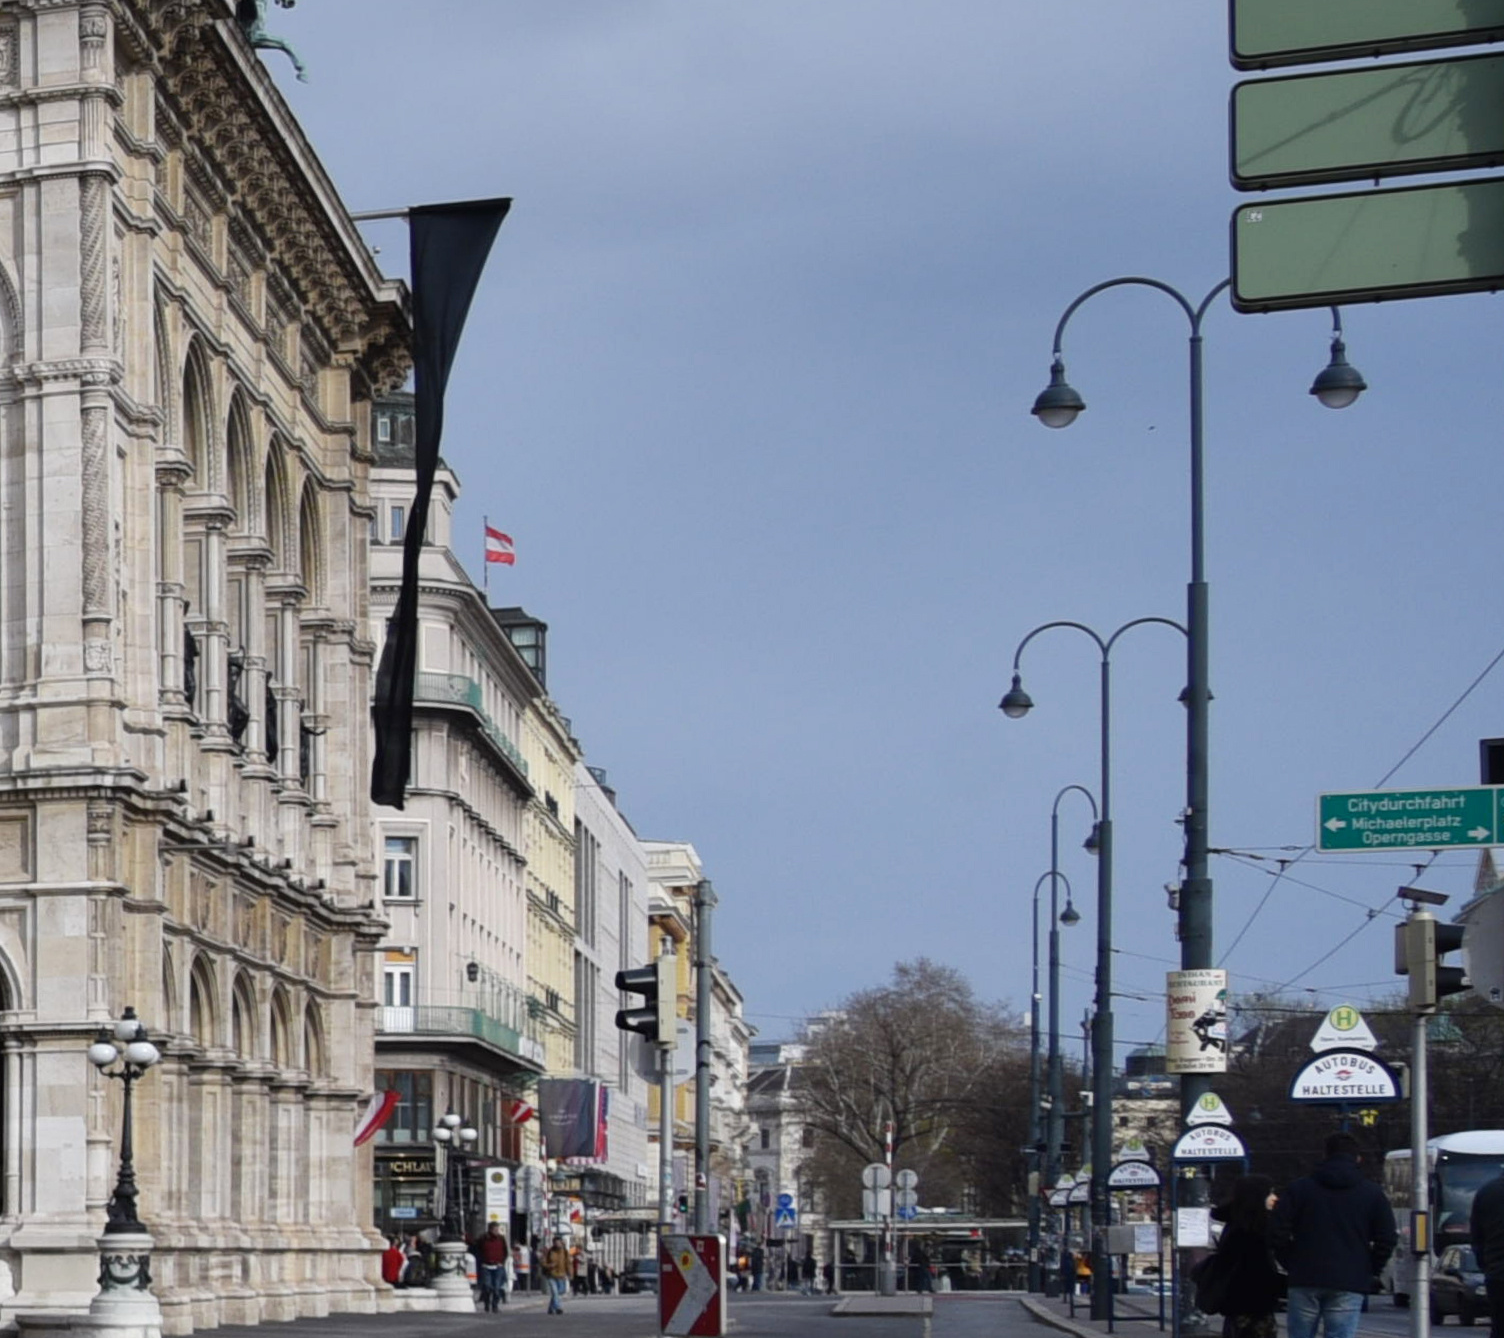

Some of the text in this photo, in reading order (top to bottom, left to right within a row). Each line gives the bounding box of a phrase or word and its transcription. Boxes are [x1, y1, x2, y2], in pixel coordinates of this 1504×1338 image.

[1348, 795, 1466, 815] Citydurchfahrt
[1351, 815, 1463, 831] Michaelerplatz
[1362, 829, 1452, 846] Operngasse
[1314, 1056, 1376, 1074] AUTOBUS
[1302, 1083, 1387, 1096] HALTESTELLE
[1181, 1147, 1238, 1155] HALTESTELLE
